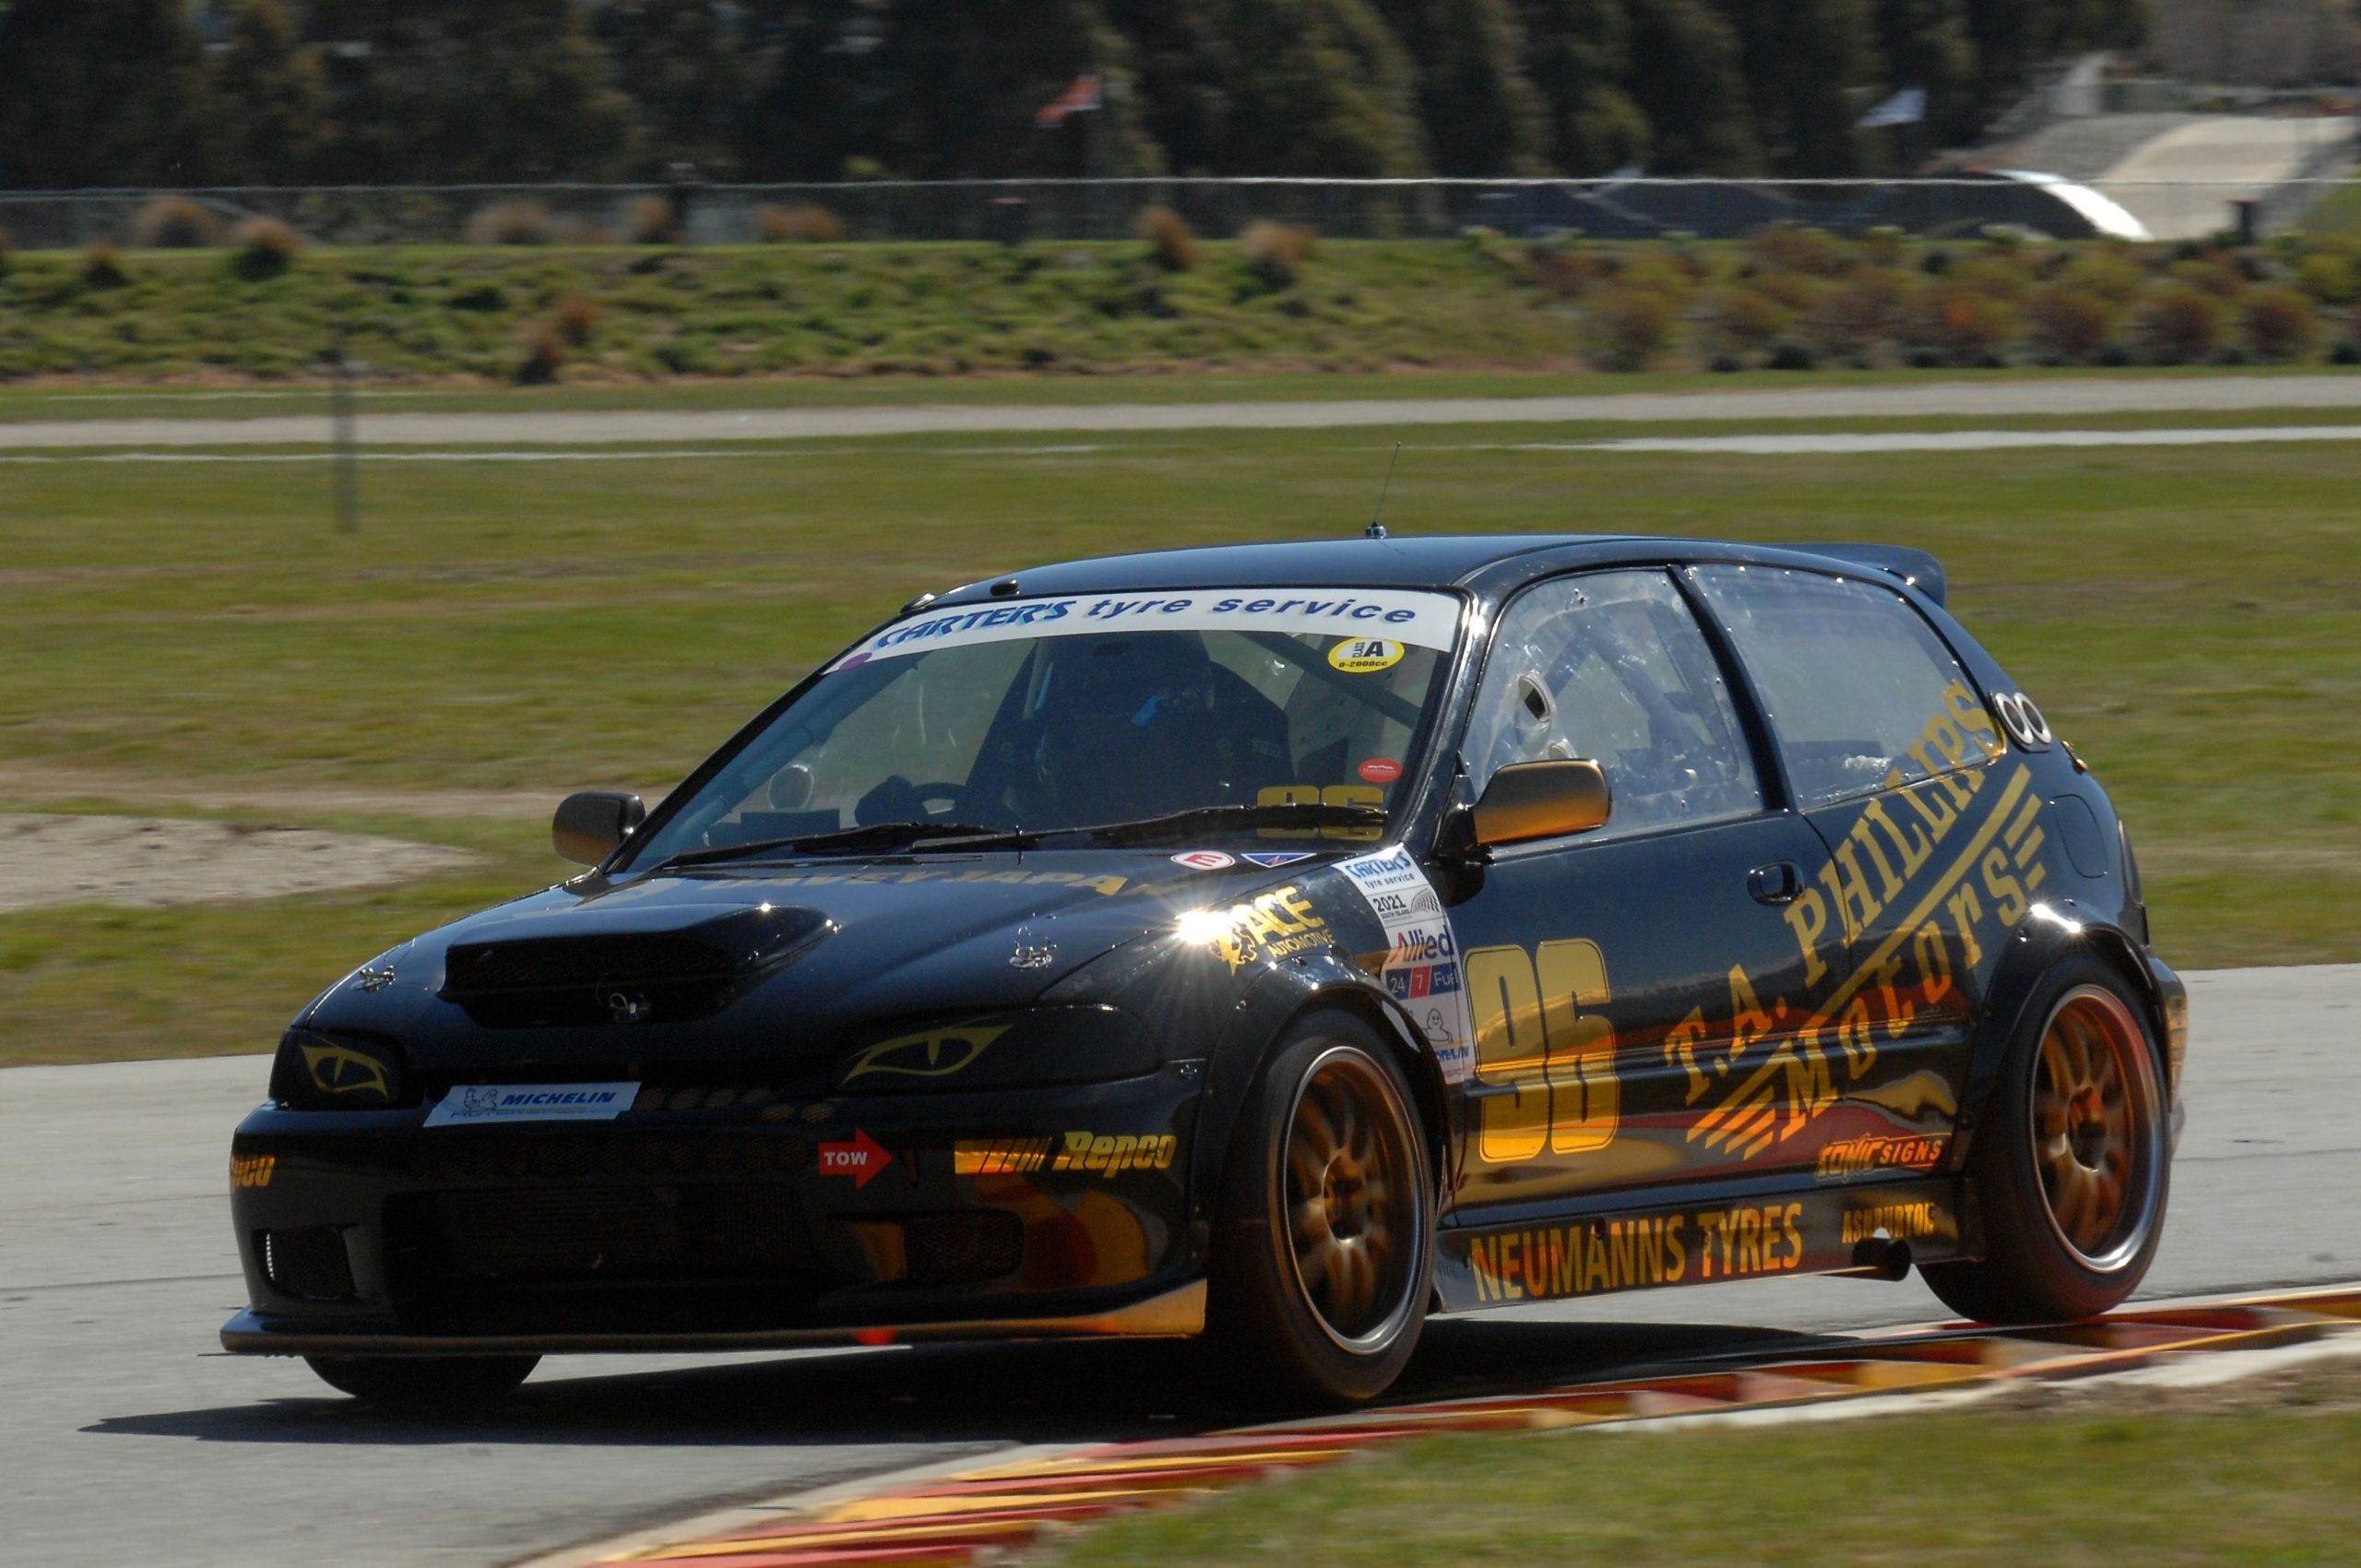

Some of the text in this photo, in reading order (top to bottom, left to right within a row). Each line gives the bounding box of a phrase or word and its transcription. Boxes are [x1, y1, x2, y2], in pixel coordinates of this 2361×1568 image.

[877, 595, 1417, 648] CARTER'S tyre service
[1363, 641, 1384, 657] A
[1365, 873, 1415, 889] tyre service
[1664, 678, 2005, 1106] T.A. PHILLIPS
[1373, 894, 1406, 912] 2021
[1266, 929, 1335, 958] AUTOMOTIVE
[1388, 923, 1454, 963] Allied
[1391, 977, 1406, 992] 24
[1416, 975, 1423, 990] 7
[1463, 937, 1620, 1164] 96
[501, 1092, 617, 1107] MICHELIN
[824, 1152, 868, 1165] TOW
[1053, 1131, 1178, 1179] Repco
[1880, 1140, 1944, 1164] SIGNS
[1470, 1202, 1803, 1301] NEUMANNS TYRES
